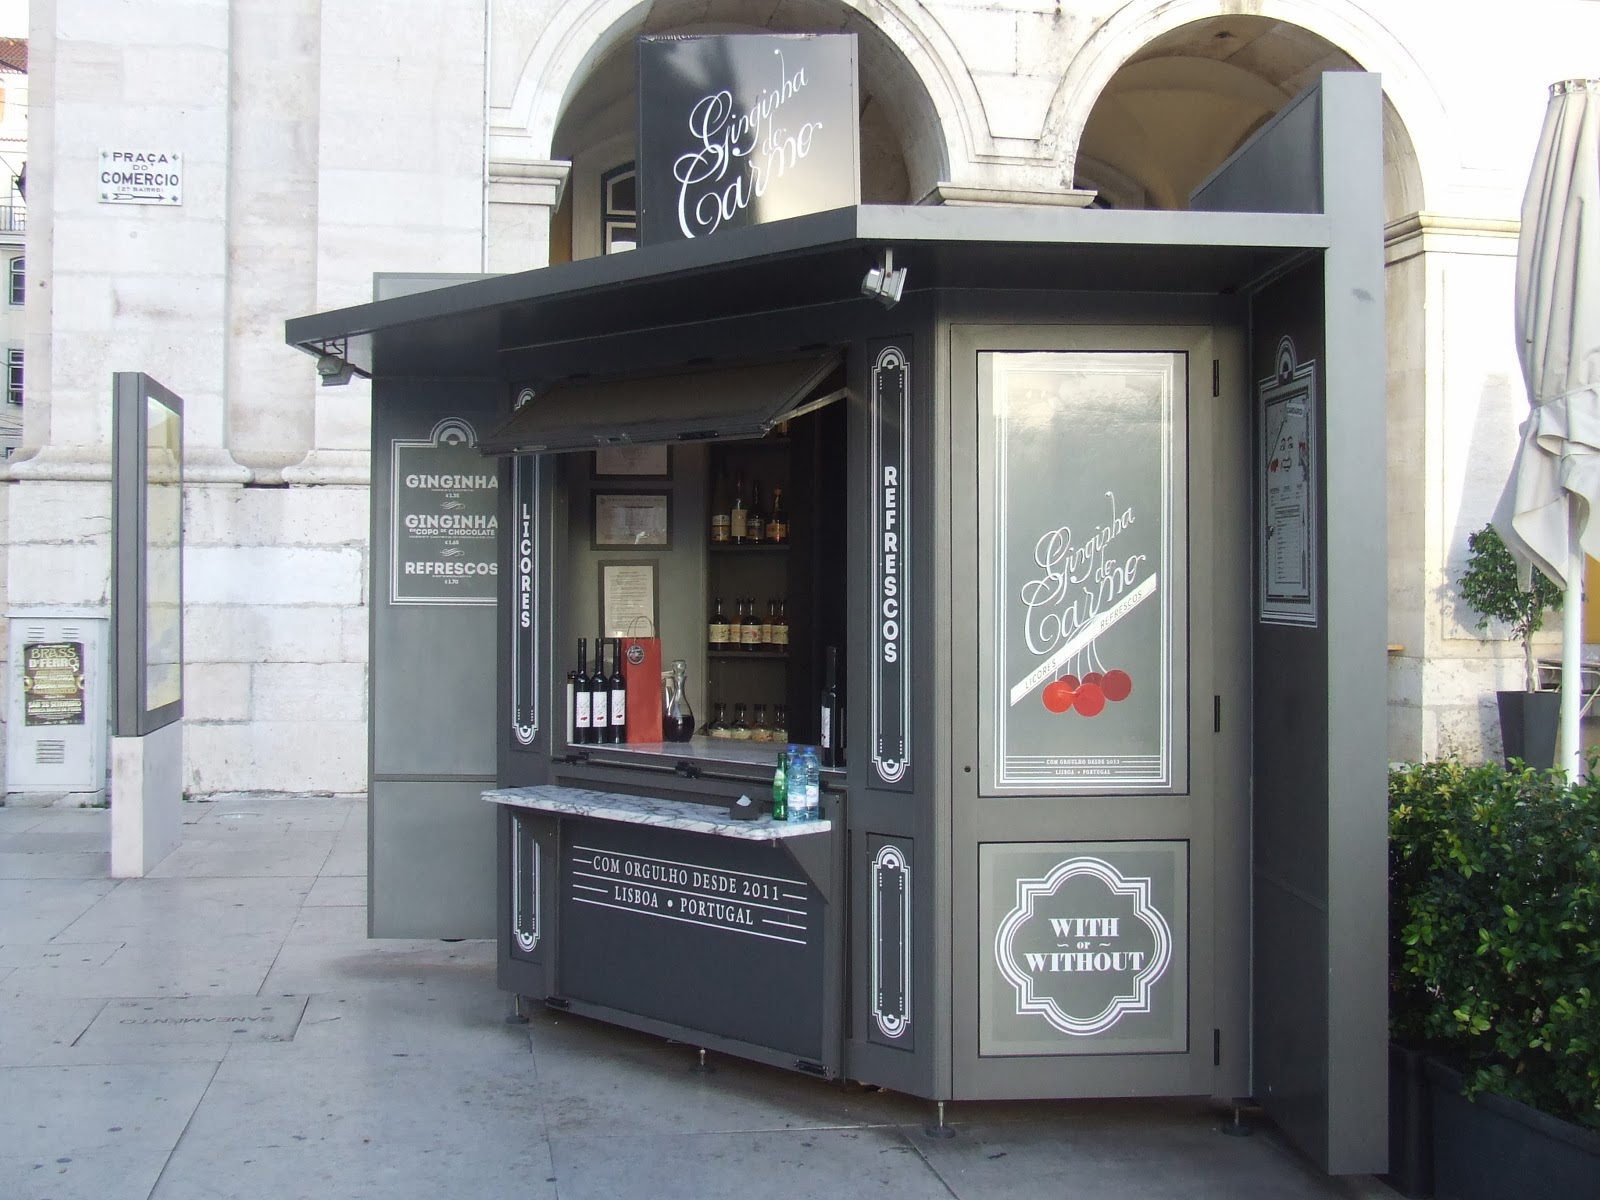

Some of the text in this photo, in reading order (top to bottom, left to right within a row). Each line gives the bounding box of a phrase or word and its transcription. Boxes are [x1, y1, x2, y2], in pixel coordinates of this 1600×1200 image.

[689, 49, 808, 181] Ginginha
[112, 151, 169, 166] PRAÇA
[101, 171, 179, 186] COMERCIO
[673, 122, 823, 239] Carmo
[405, 474, 499, 489] GINGINHA
[405, 514, 499, 529] GINGINHA
[415, 528, 439, 536] COPO
[448, 528, 495, 536] CHOCOLATE
[1034, 490, 1136, 606] Ginginha
[405, 562, 498, 575] REFRESCOS
[520, 503, 532, 628] LICORES
[882, 466, 899, 663] REFRESCOS
[1021, 554, 1147, 655] Carmo
[1024, 589, 1143, 690] LICORES REFRESCOS
[31, 647, 76, 659] BRASS
[1087, 758, 1105, 766] DESDE
[592, 855, 779, 901] COM ORGULHO DESDE 2011
[614, 885, 754, 925] LISBOA PORTUGAL
[1048, 917, 1120, 938] WITH
[1076, 940, 1091, 950] or
[1023, 951, 1145, 973] WITHOUT
